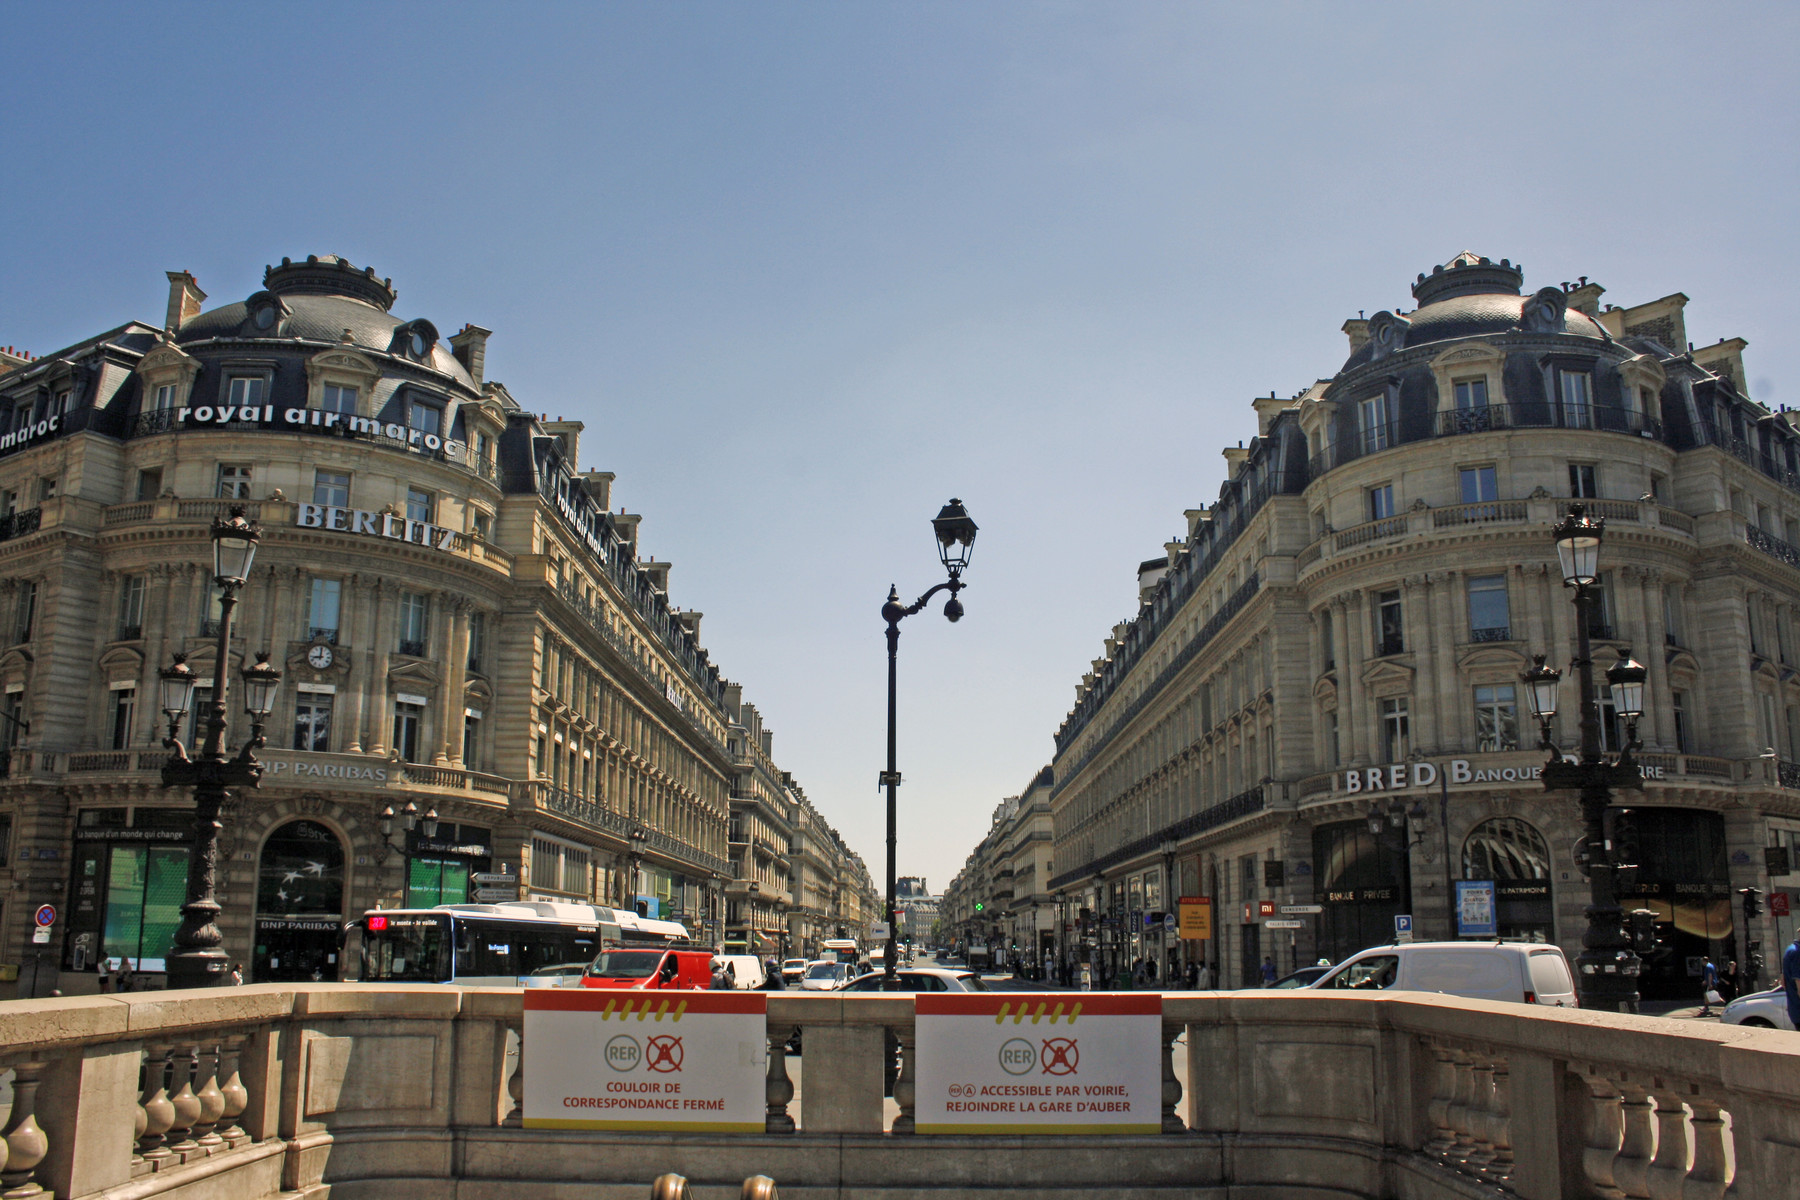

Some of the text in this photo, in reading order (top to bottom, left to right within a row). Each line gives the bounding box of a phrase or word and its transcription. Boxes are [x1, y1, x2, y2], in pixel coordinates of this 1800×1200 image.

[0, 415, 59, 449] maroc
[178, 405, 458, 456] royal air maroc
[296, 503, 458, 552] BERLITZ
[557, 493, 607, 564] royal air maroc
[257, 761, 387, 781] NP PARIBAS
[1346, 762, 1436, 793] BRED
[85, 831, 104, 839] banque
[121, 830, 143, 838] monde
[144, 831, 155, 839] qui
[156, 831, 184, 839] change
[261, 922, 337, 930] BNP PARIBAS
[1400, 918, 1407, 929] P
[609, 1046, 637, 1061] RER
[1004, 1050, 1031, 1064] RER
[606, 1082, 681, 1093] COULOIR DE
[965, 1087, 973, 1095] A
[980, 1085, 1052, 1096] ACCESSIBLE
[1056, 1086, 1080, 1096] PAR
[1084, 1085, 1129, 1098] VOIRIE,
[563, 1097, 725, 1110] CORRESPONDANCE FERMÉ
[946, 1102, 1130, 1113] REJOINDRE LA GARE D'AUBER
